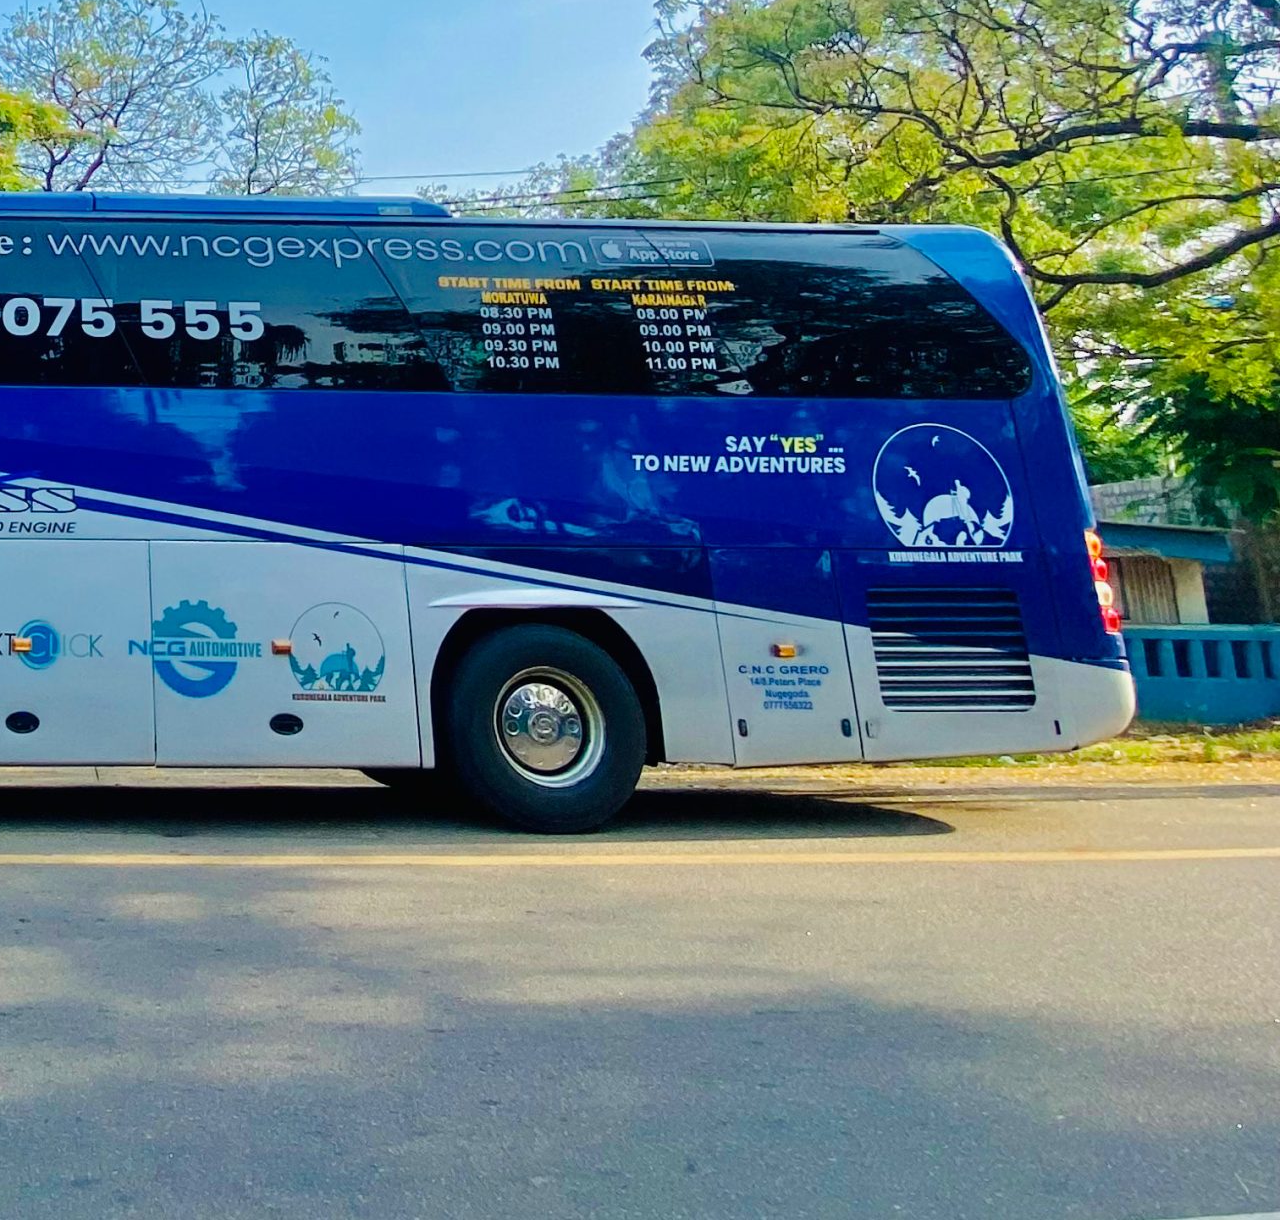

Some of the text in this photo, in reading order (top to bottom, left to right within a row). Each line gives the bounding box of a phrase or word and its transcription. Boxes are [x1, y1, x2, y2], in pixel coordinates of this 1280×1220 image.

[47, 233, 588, 268] www.ncgexpress.com
[629, 247, 700, 262] App Store
[438, 276, 581, 290] START TIME FROM
[591, 278, 642, 291] START
[644, 280, 684, 291] TIME
[481, 291, 548, 305] MORATUWA
[631, 293, 707, 307] KARAINAGAR
[2, 296, 116, 338] 075
[140, 299, 265, 341] 555
[480, 307, 553, 319] 08.30 PM
[636, 308, 708, 321] 08.00 PM
[482, 323, 556, 336] 09.00 PM
[639, 324, 712, 337] 09.00 PM
[484, 339, 558, 352] 09.30 PM
[642, 340, 715, 353] 10.00 PM
[487, 356, 560, 368] 10.30 PM
[645, 357, 717, 370] 11.00 PM
[725, 436, 766, 453] SAY
[632, 454, 846, 474] TO NEW ADVENTURES
[8, 521, 77, 534] ENGINE
[947, 551, 999, 563] ADVENTURE
[128, 639, 263, 659] NCG AUTOMOTIVE
[779, 665, 830, 675] GRERO
